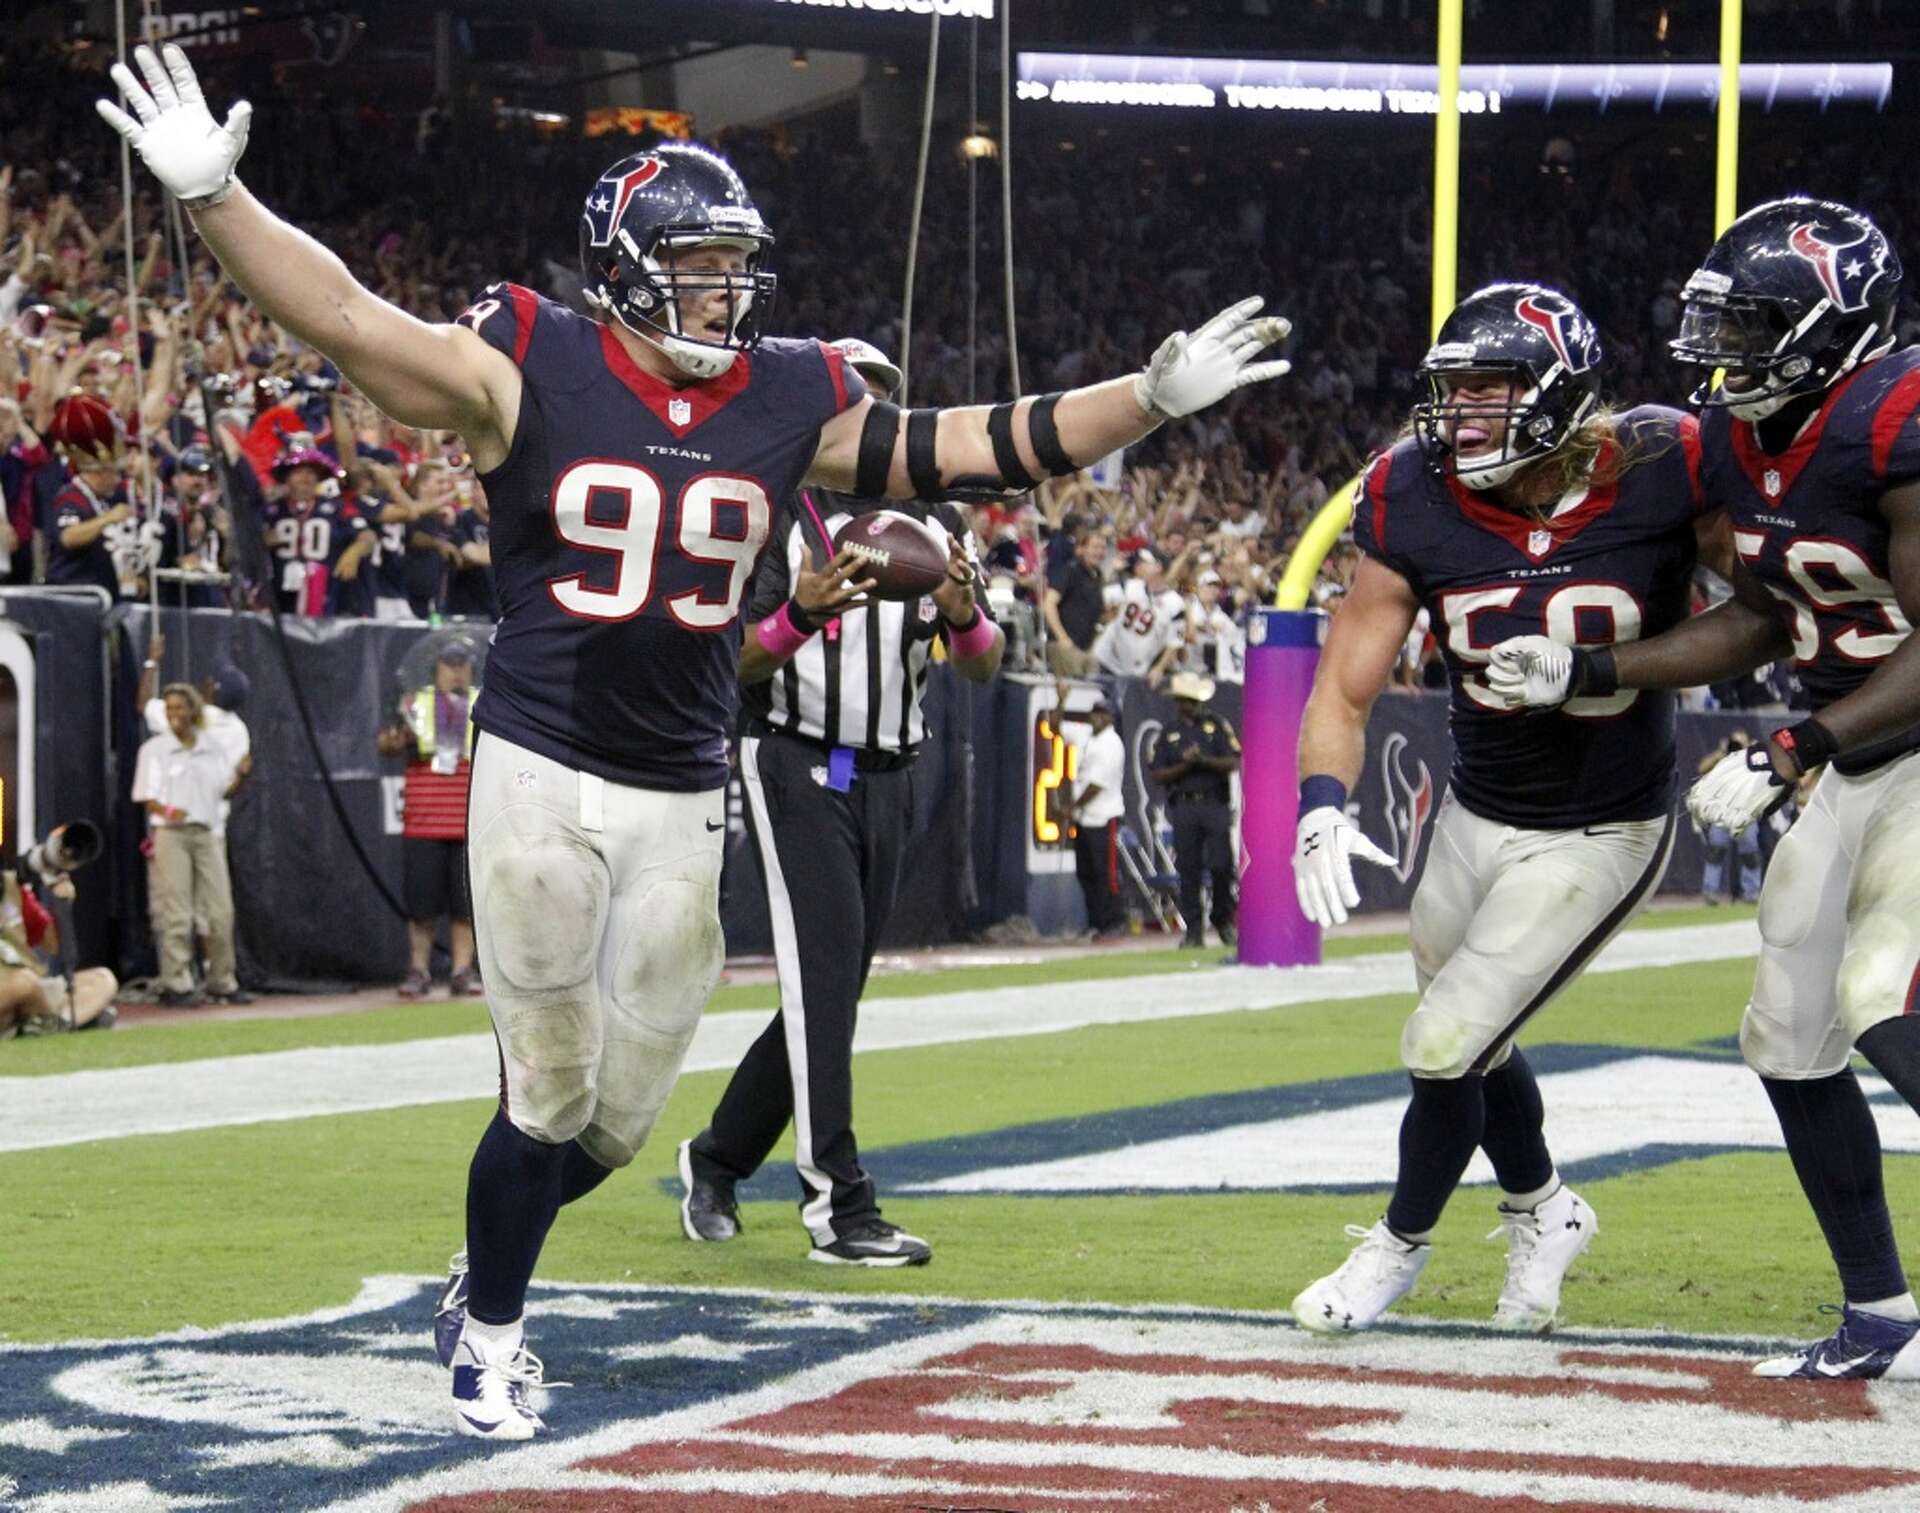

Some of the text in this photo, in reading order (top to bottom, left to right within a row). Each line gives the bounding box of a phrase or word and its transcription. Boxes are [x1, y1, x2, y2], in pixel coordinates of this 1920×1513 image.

[645, 446, 711, 461] TEXANS
[1754, 514, 1796, 528] TEXANS
[275, 517, 332, 560] 90
[546, 456, 772, 632] 99
[1507, 565, 1572, 579] TEXANS
[1123, 602, 1154, 636] 99
